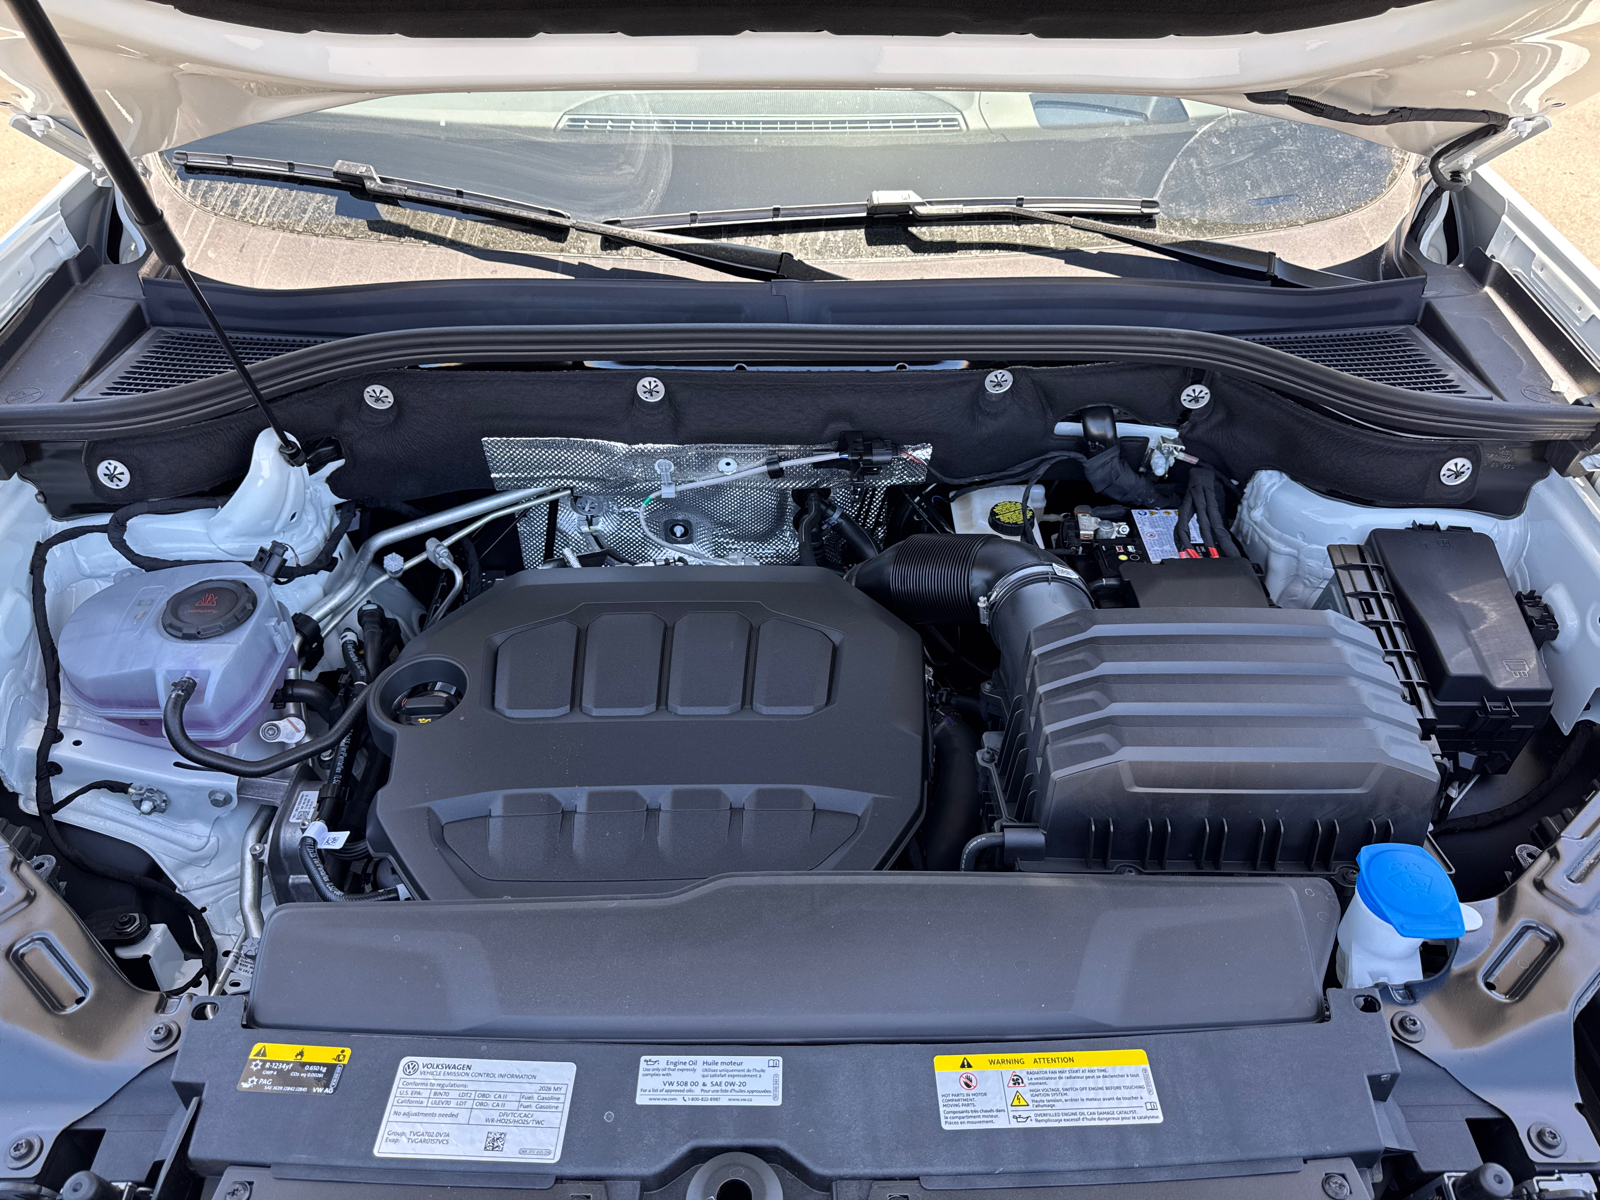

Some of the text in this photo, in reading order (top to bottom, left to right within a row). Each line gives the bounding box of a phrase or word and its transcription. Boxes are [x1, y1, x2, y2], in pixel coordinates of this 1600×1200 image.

[1033, 1056, 1074, 1064] ATTENTION
[265, 1062, 293, 1071] R-1234yf
[422, 1062, 472, 1071] VOLKSWAGEN
